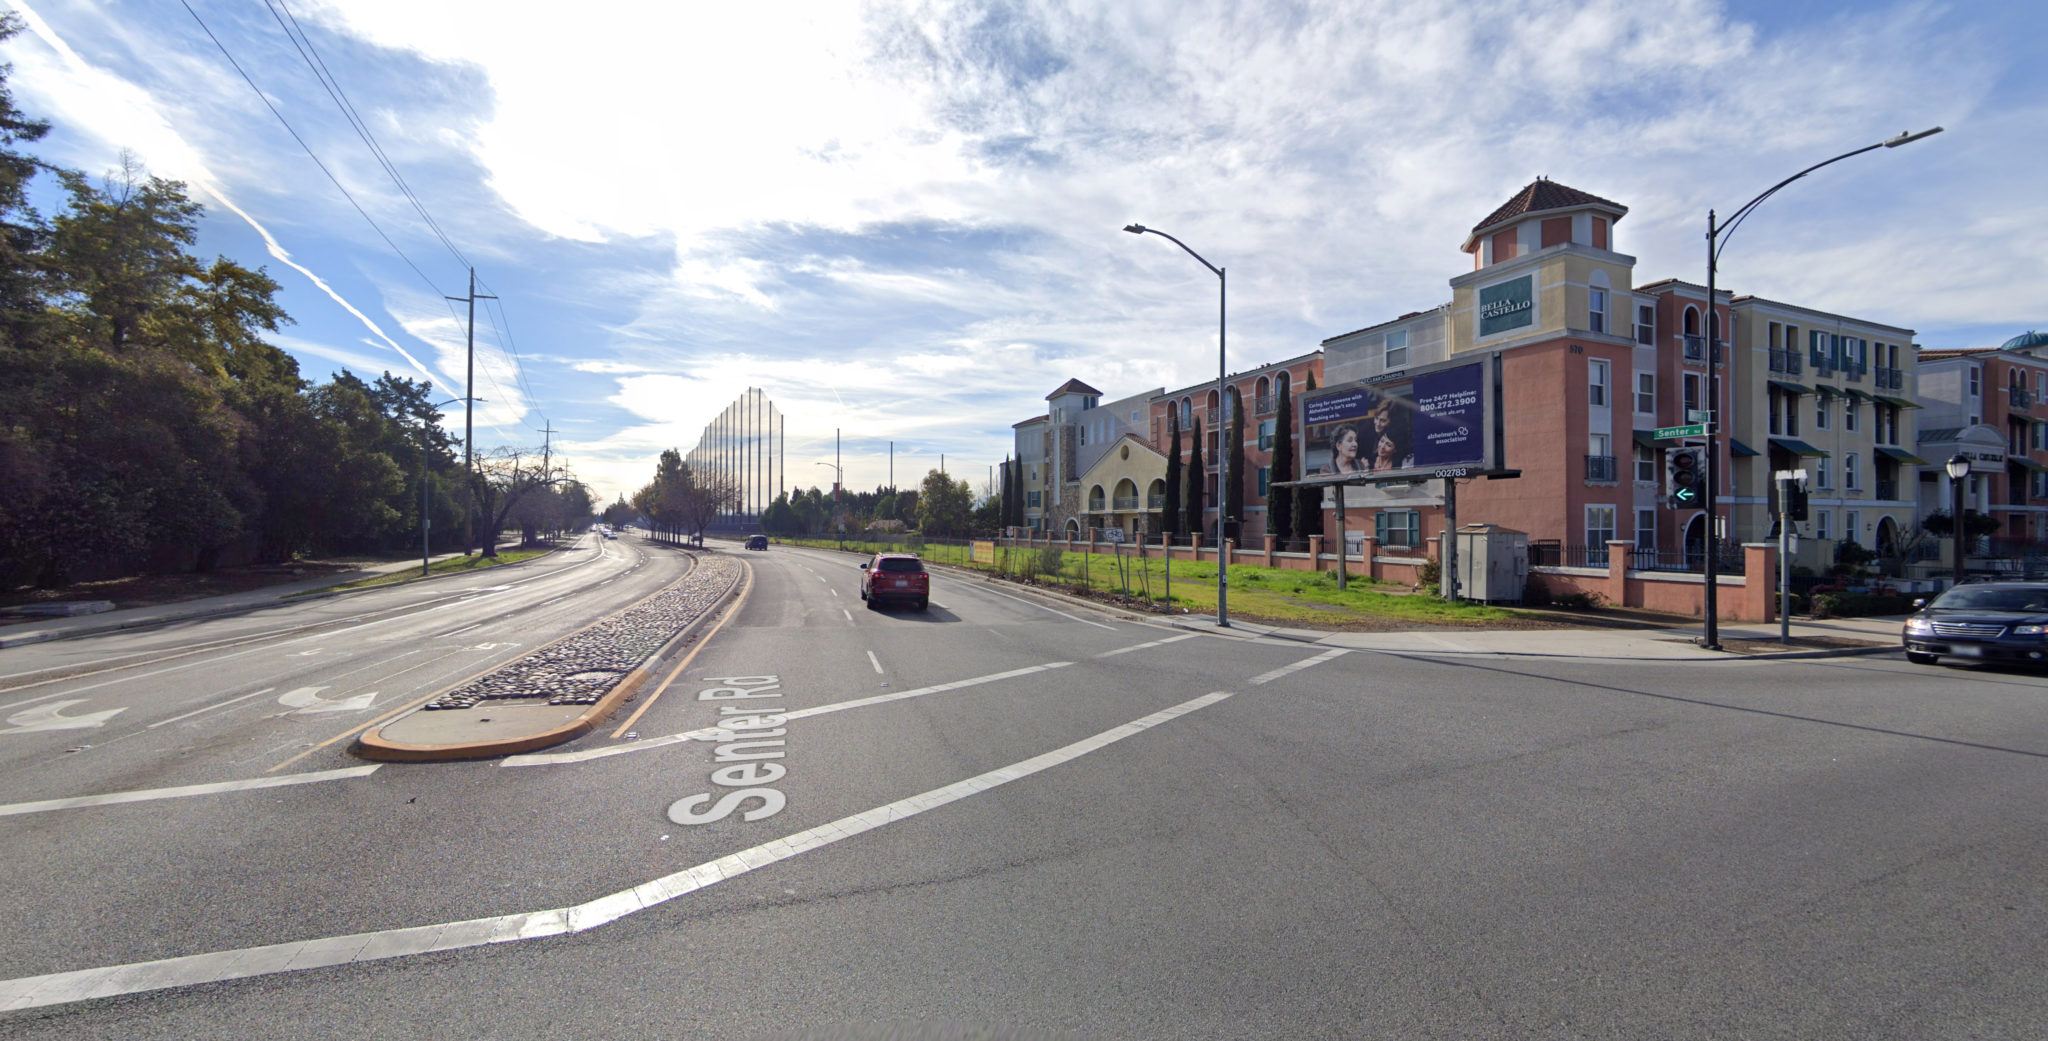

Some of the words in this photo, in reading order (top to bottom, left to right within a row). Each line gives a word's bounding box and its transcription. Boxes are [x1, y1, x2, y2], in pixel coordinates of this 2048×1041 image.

[1481, 299, 1511, 312] BELLA
[1481, 300, 1531, 320] CASTELLO
[1433, 394, 1448, 402] 24/7
[1449, 390, 1477, 399] Helpline:
[1420, 396, 1477, 412] 800.272.3900
[1427, 431, 1458, 440] alzheimer's
[1658, 428, 1690, 437] Senter
[1435, 436, 1468, 445] association
[1435, 468, 1467, 478] 002783
